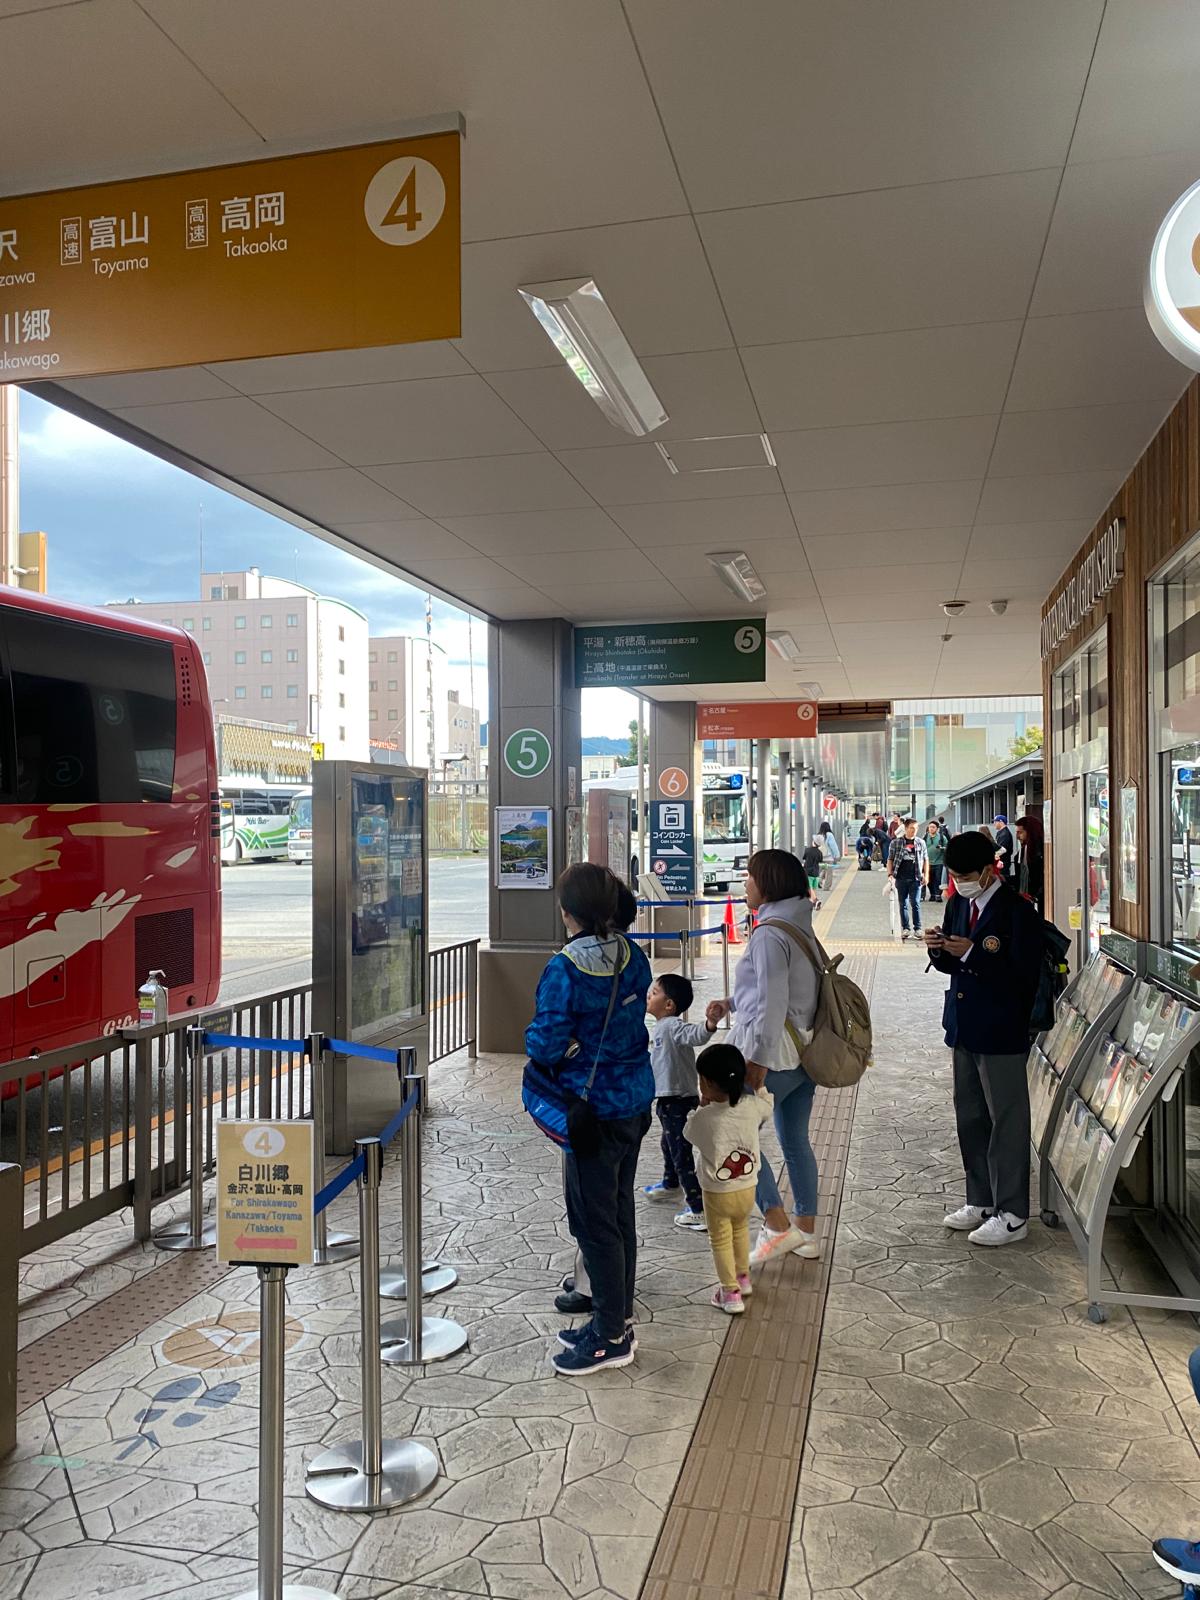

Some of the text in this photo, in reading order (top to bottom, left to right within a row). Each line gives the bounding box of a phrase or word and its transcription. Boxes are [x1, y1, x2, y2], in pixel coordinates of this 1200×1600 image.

[380, 164, 422, 231] 4
[63, 223, 79, 260] 高速
[88, 211, 149, 251] 富山
[189, 206, 205, 243] 高速
[220, 191, 285, 233] 高岡
[92, 256, 149, 278] Toyama
[224, 233, 288, 258] Takaoka
[1079, 548, 1097, 616] GIFT
[1097, 518, 1121, 597] SHOP
[741, 629, 754, 649] 5
[583, 661, 616, 674] 上高地
[801, 706, 810, 718] 6
[517, 737, 538, 770] 5
[668, 772, 680, 792] 6
[825, 798, 835, 809] 7
[652, 831, 691, 839] コインロッカー
[254, 1131, 272, 1154] 4
[238, 1164, 289, 1182] 白川郷
[227, 1183, 304, 1196] 金沢・富山・高岡
[231, 1197, 298, 1208] For Shirakawago
[225, 1210, 303, 1222] Kanazawa/Toyama
[245, 1223, 285, 1233] /Takaoka
